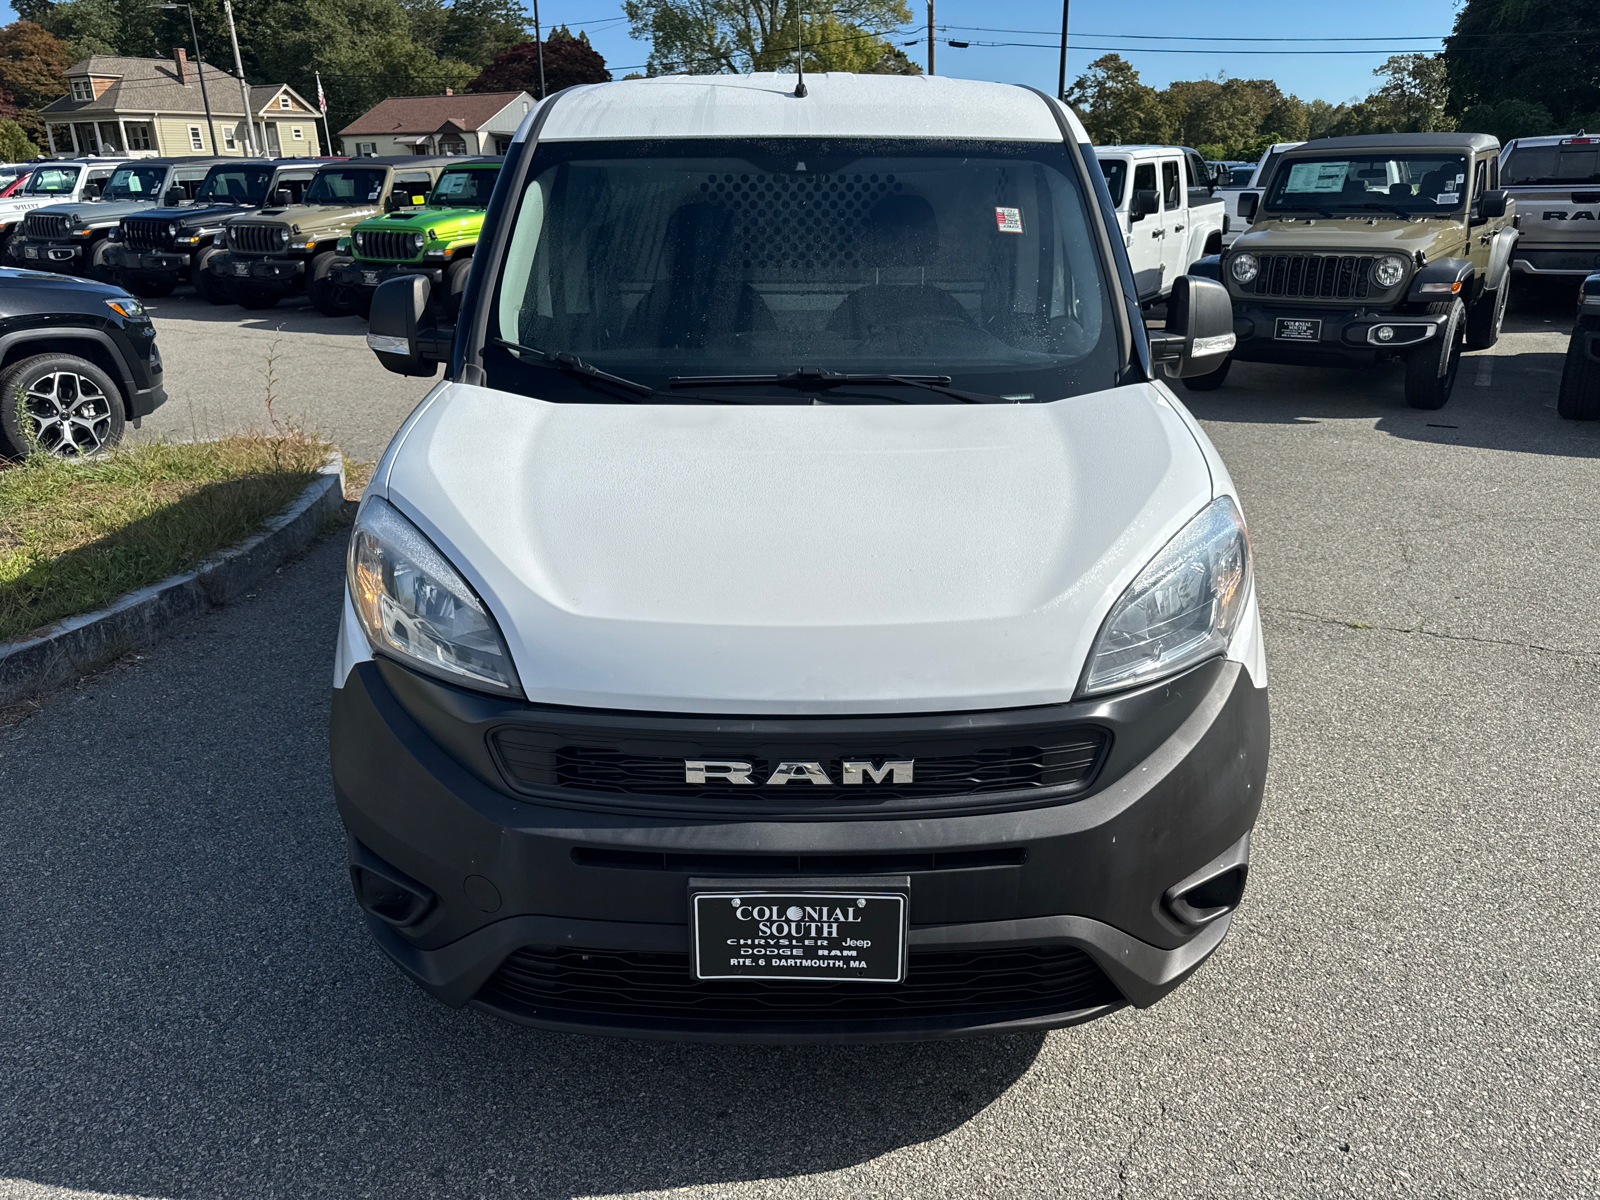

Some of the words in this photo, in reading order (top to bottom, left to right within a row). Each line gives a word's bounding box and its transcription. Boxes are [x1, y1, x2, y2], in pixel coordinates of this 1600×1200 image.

[1542, 211, 1600, 220] RA
[685, 759, 915, 785] RAM
[735, 906, 862, 922] COLONIAL
[758, 922, 839, 937] SOUTH
[842, 938, 871, 948] Jeep
[730, 958, 755, 966] RTE.
[772, 959, 846, 968] DARTMOUTH,
